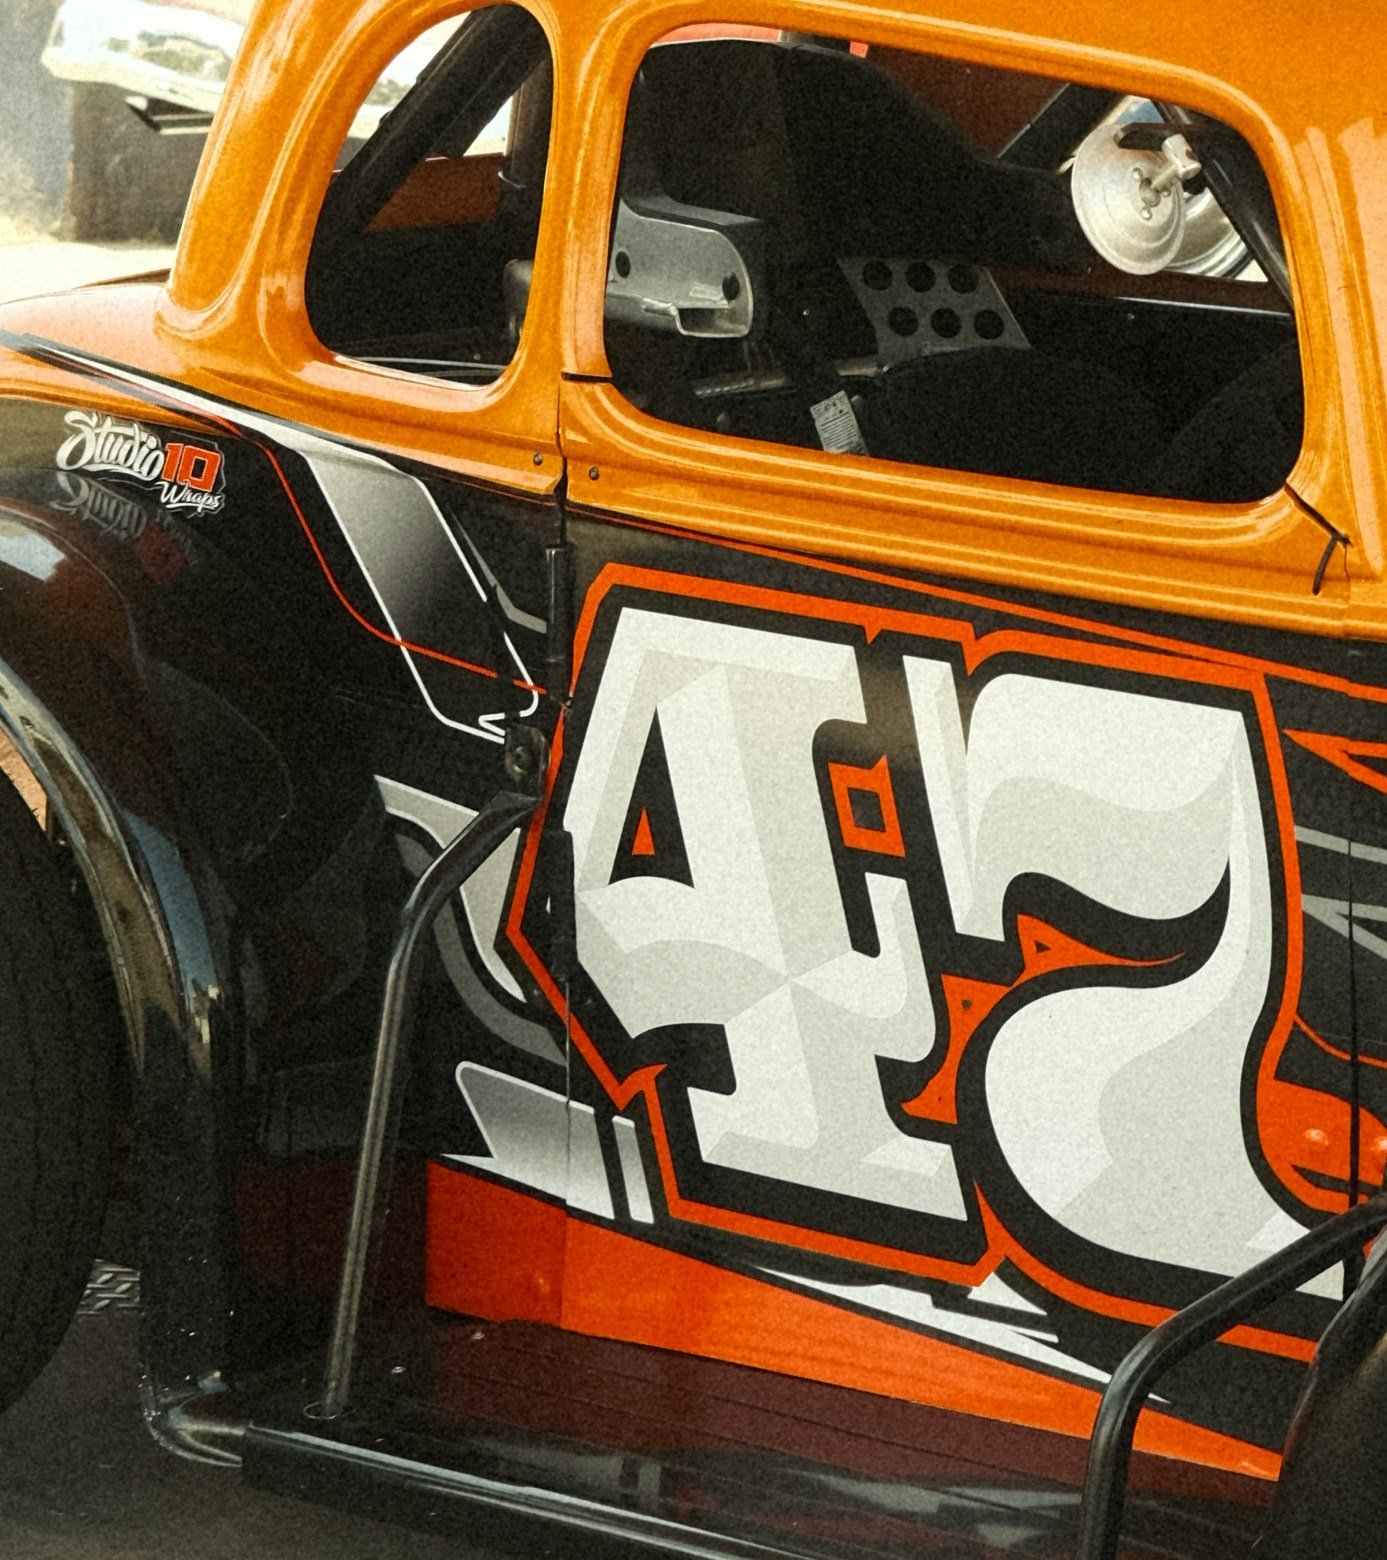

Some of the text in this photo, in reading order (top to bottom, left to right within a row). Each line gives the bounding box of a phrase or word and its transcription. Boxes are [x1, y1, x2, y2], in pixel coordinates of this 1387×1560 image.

[56, 410, 222, 493] Studio 10
[155, 480, 224, 513] Wraps
[562, 606, 1346, 1301] 47
